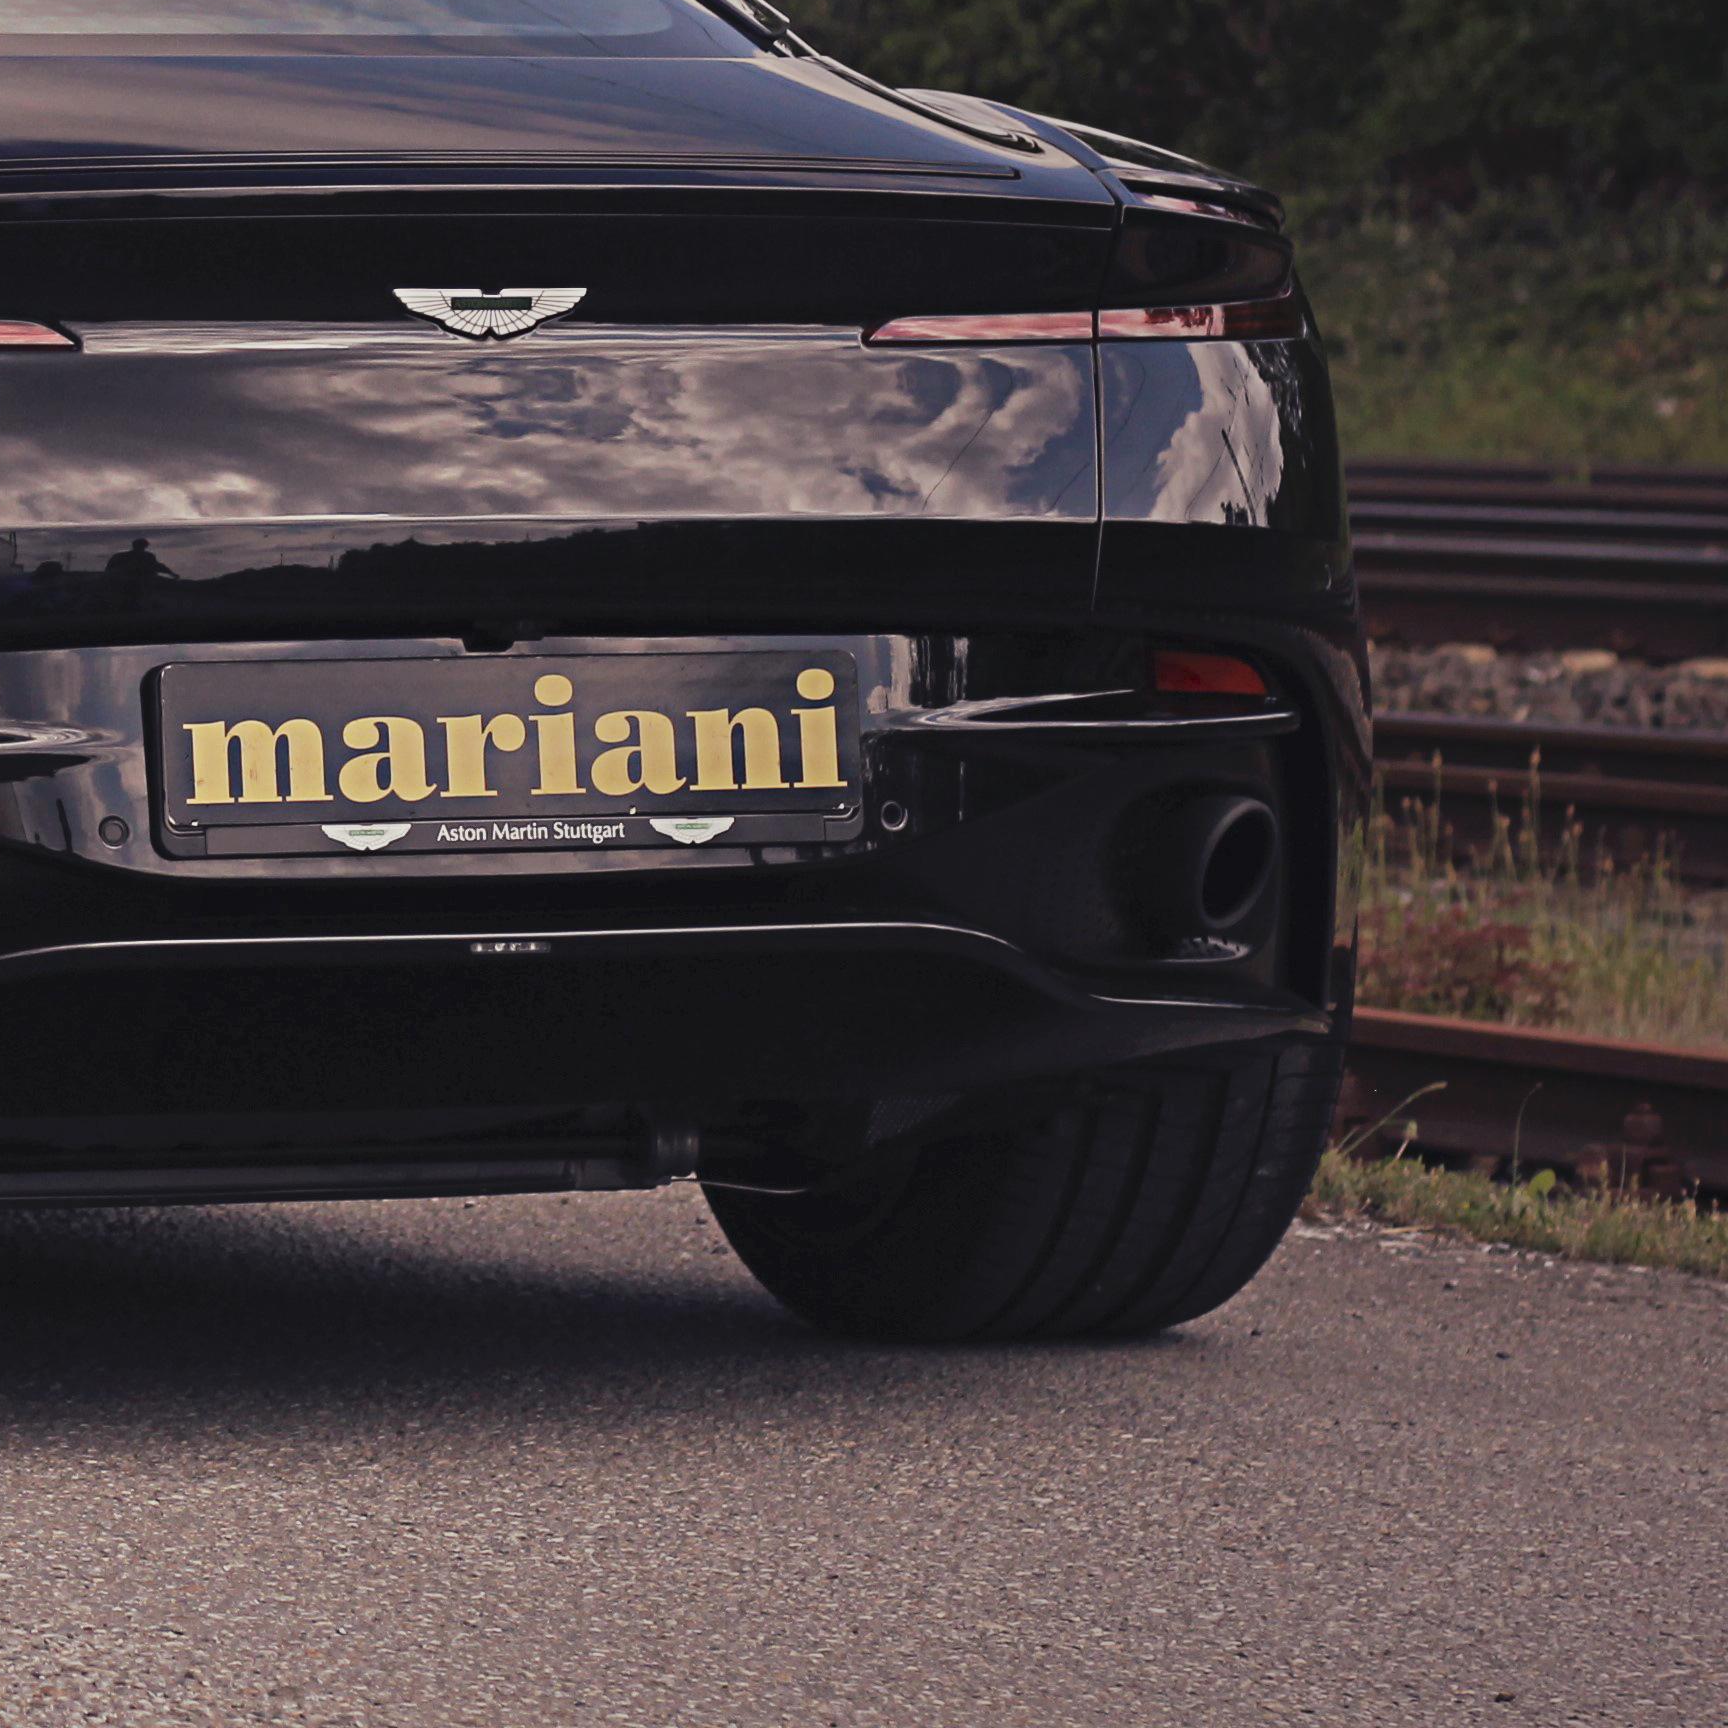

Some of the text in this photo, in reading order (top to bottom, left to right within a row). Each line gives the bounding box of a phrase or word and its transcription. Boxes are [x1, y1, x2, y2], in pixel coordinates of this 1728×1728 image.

[182, 668, 848, 805] mariani
[436, 821, 626, 844] Aston Martin Stuttgart
